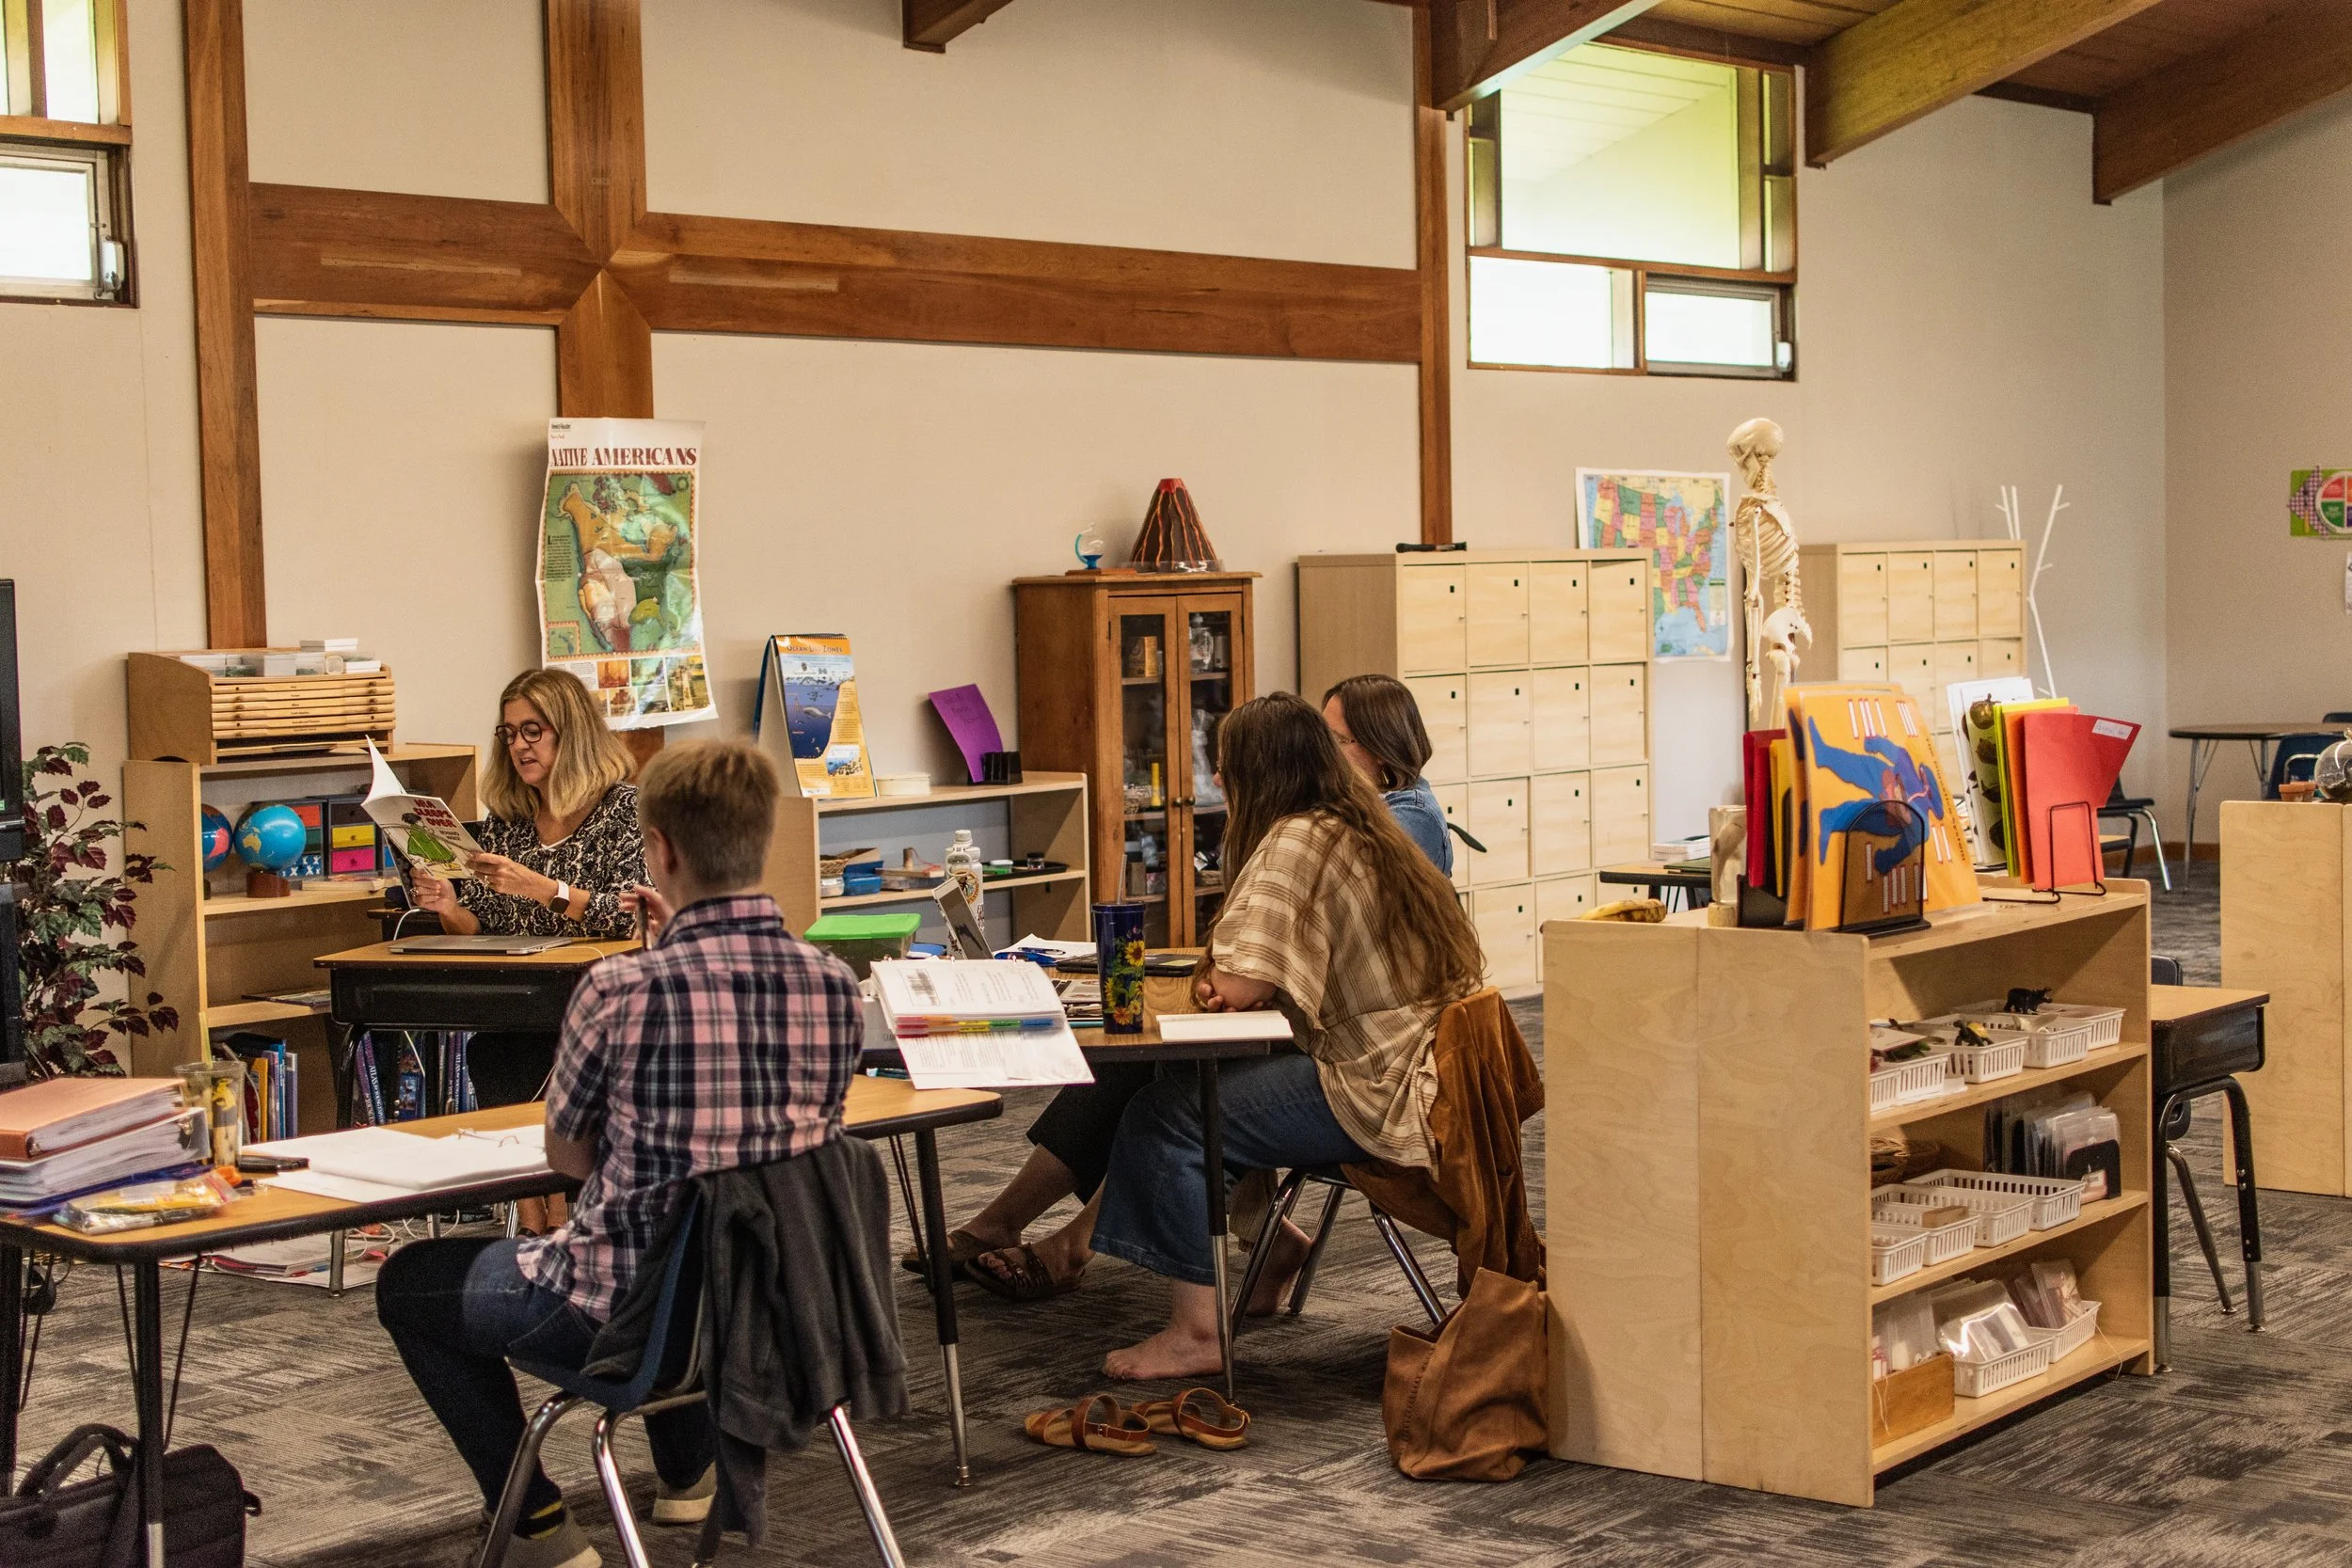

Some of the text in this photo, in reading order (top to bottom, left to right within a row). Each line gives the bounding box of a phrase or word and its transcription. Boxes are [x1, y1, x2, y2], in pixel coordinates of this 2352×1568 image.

[550, 447, 696, 467] NATIVE AMERICANS
[414, 799, 437, 809] IRA
[413, 807, 453, 818] SLEEPS
[426, 817, 457, 828] OVER
